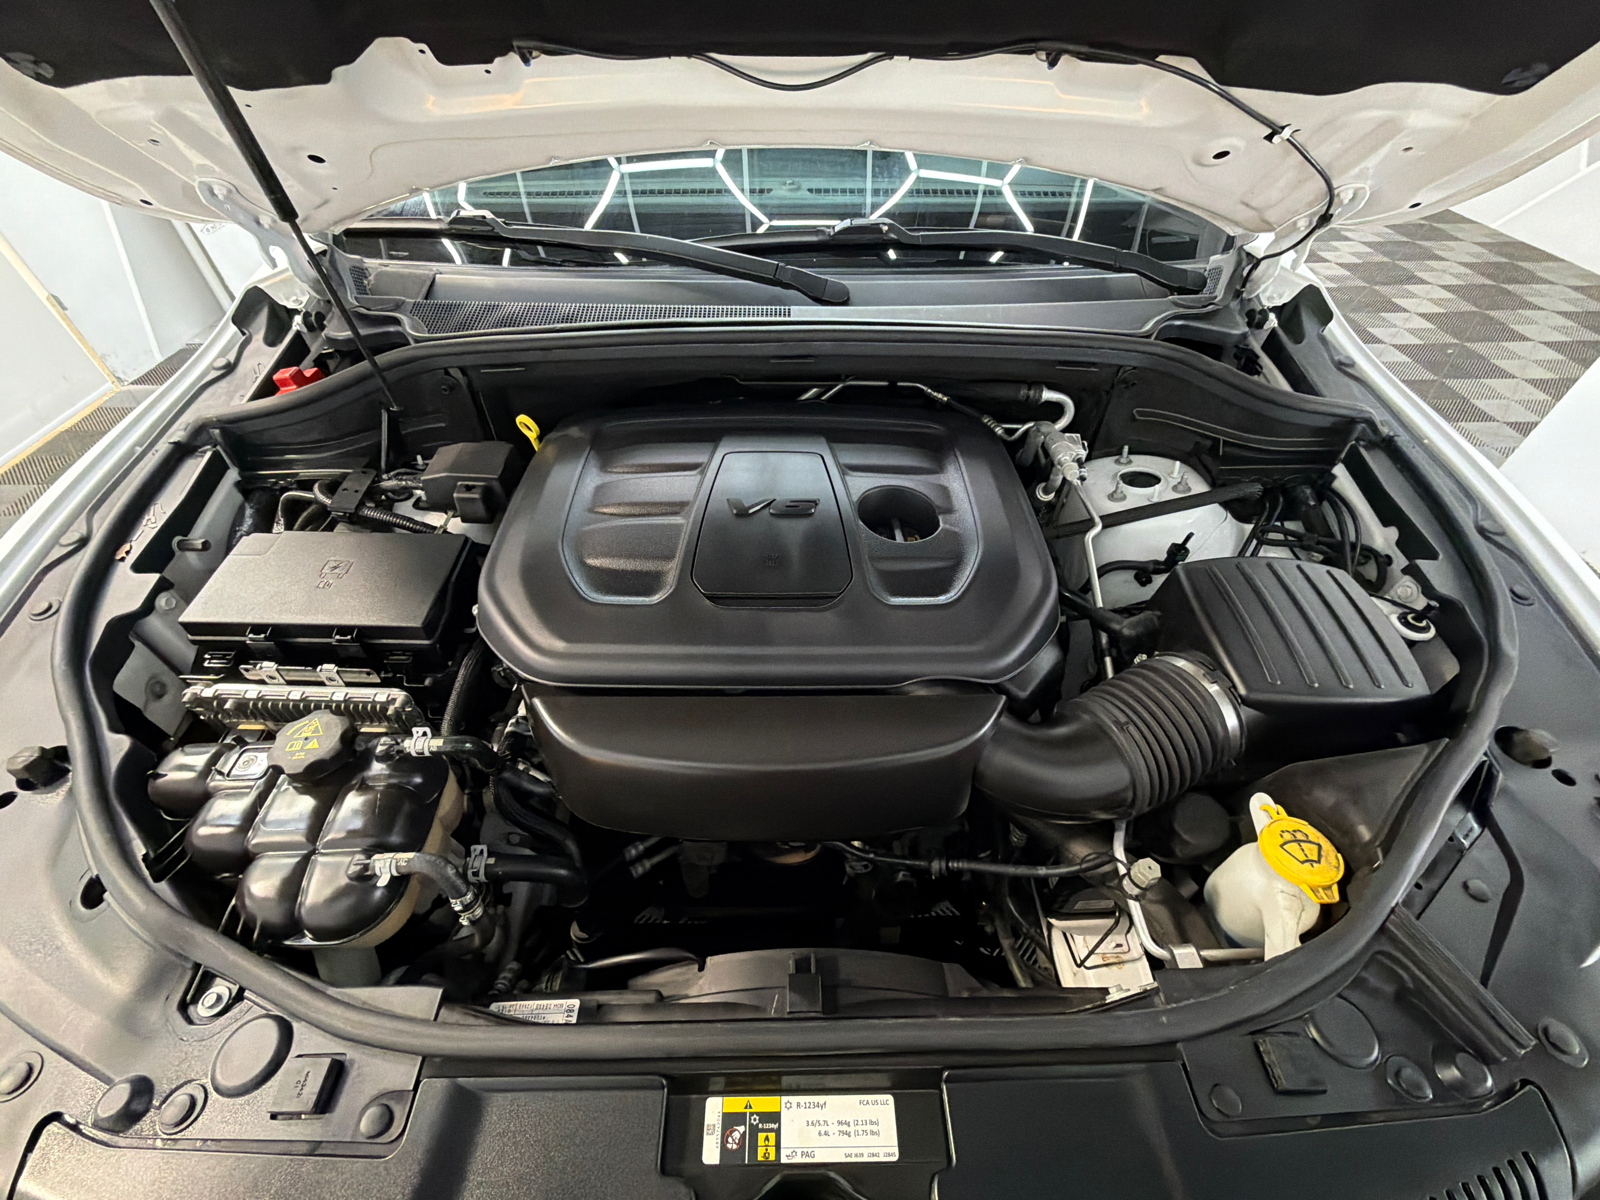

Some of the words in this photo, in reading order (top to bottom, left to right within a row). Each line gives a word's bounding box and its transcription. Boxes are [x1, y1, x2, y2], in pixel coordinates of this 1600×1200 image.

[726, 498, 820, 517] V6
[796, 1101, 827, 1111] R-1234yf
[836, 1119, 851, 1128] 964g
[853, 1119, 868, 1127] (2.13
[868, 1119, 880, 1127] lbs)
[837, 1130, 852, 1138] 794g
[853, 1130, 869, 1138] (1.75
[869, 1129, 881, 1138] lbs)
[800, 1150, 816, 1159] PAG
